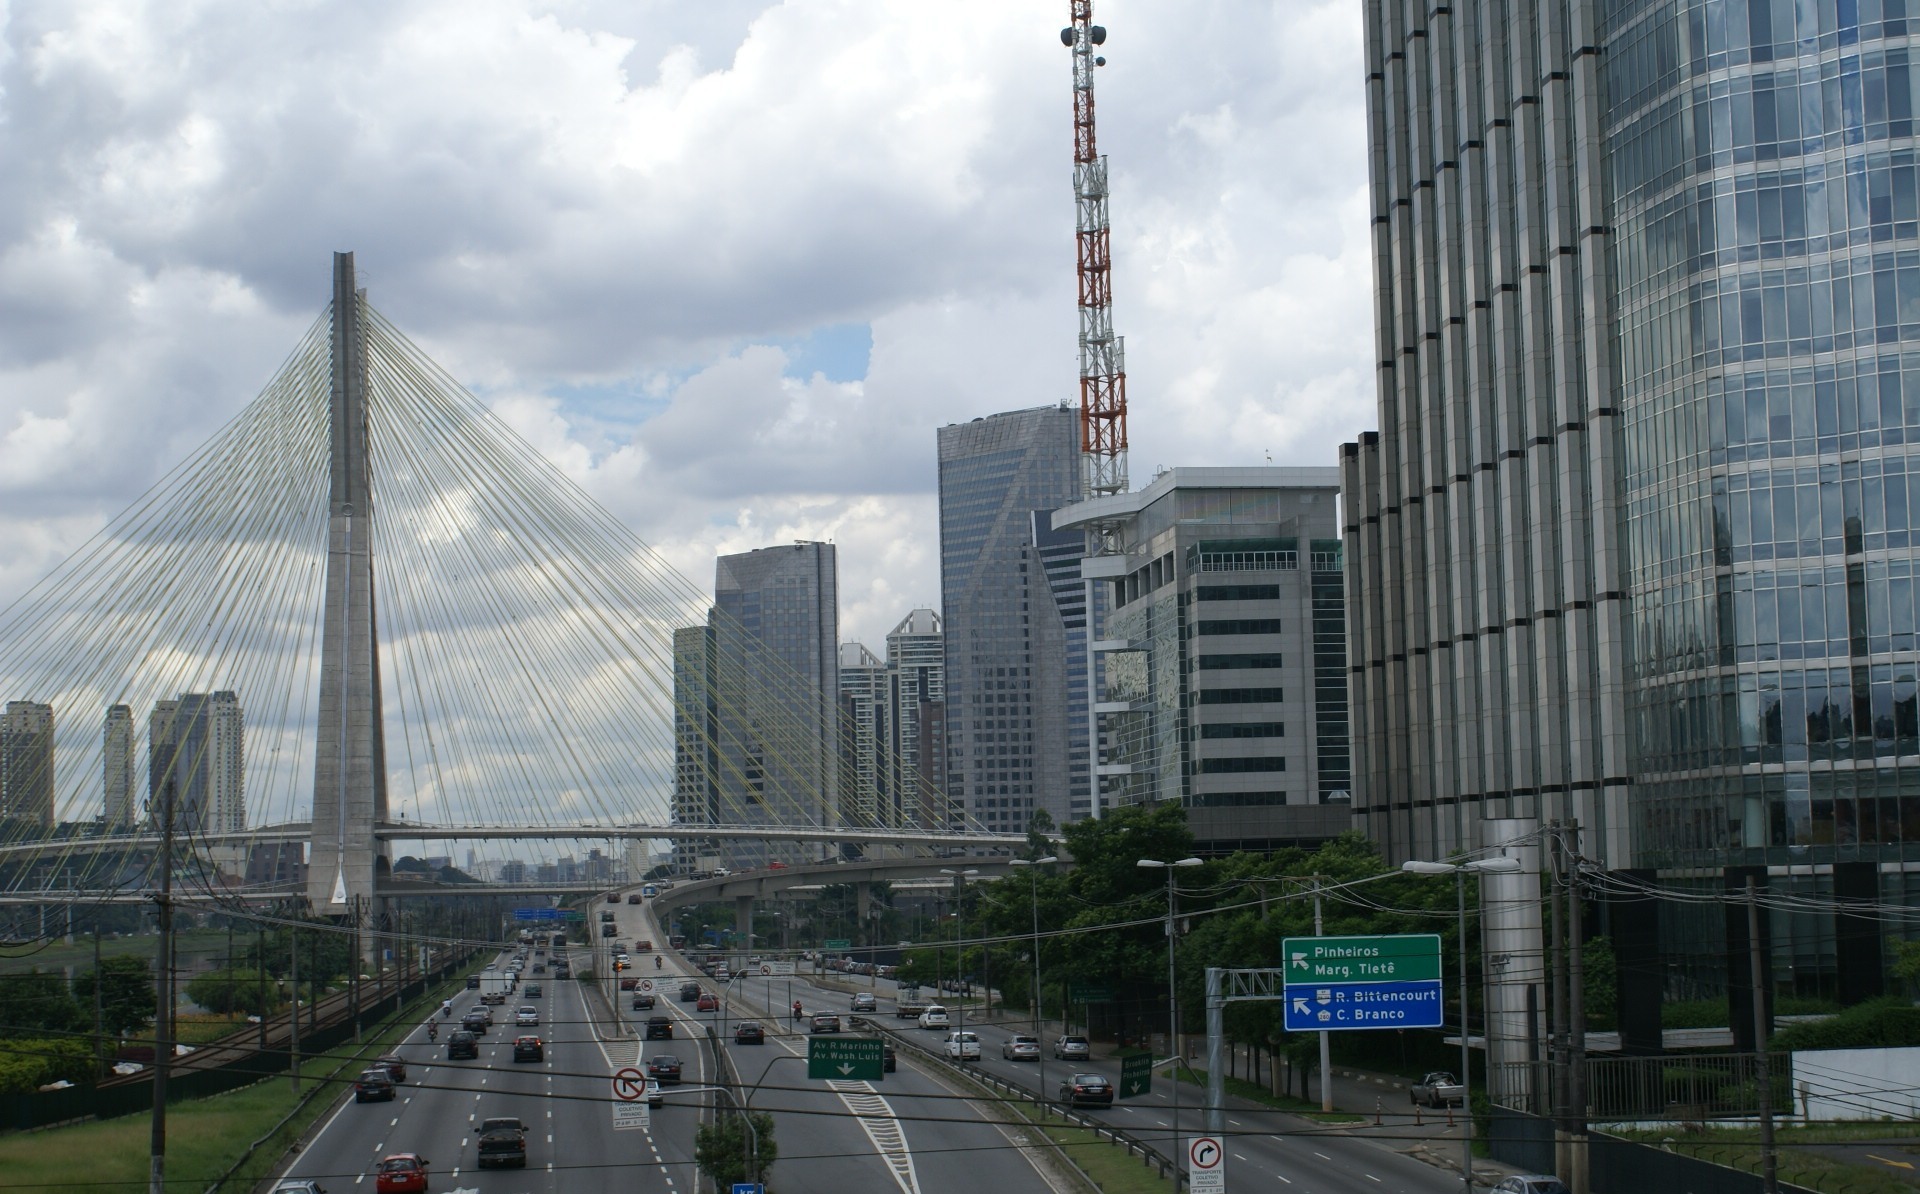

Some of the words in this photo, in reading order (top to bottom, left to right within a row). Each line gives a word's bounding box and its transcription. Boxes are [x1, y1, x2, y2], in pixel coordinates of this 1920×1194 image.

[1314, 946, 1379, 958] Pinheiros
[1315, 964, 1353, 978] Marg.
[1359, 962, 1395, 974] Tietê
[1336, 991, 1350, 1003] R.
[1354, 989, 1436, 1003] Bittencourt
[1336, 1009, 1350, 1020] C.
[1354, 1009, 1405, 1020] Branco
[840, 1042, 880, 1050] Marinho
